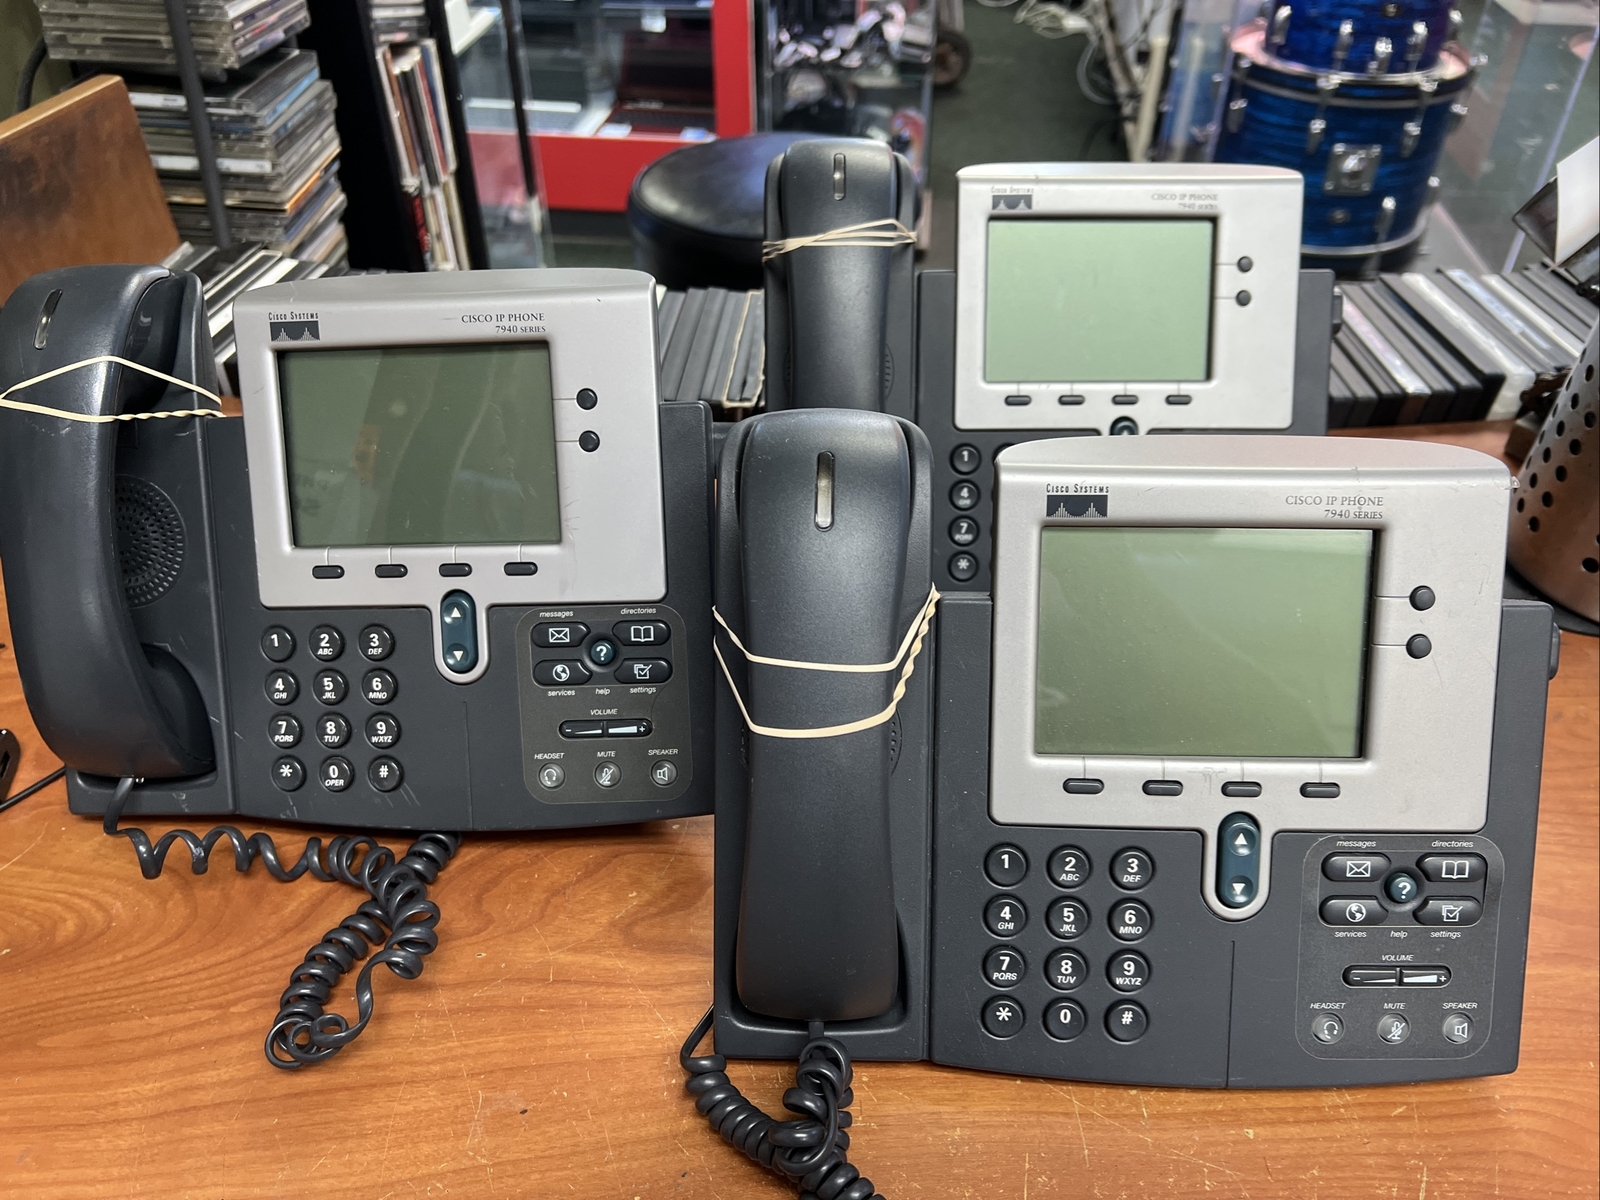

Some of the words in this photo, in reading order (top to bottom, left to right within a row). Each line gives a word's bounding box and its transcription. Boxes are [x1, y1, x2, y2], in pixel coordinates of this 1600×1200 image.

[461, 314, 493, 323] CISCO
[496, 313, 505, 322] IP
[508, 313, 545, 322] PHONE
[495, 325, 518, 333] 7940
[962, 451, 969, 461] 1
[960, 487, 969, 498] 4
[1285, 495, 1322, 505] CISCO
[1326, 496, 1337, 505] IP
[1341, 496, 1384, 507] PHONE
[1324, 509, 1351, 519] 7940
[1353, 511, 1383, 519] SERIES
[960, 523, 968, 533] 7
[539, 610, 574, 618] messages
[620, 607, 657, 615] directories
[271, 633, 279, 647] 1
[320, 633, 330, 647] 2
[369, 633, 380, 647] 3
[275, 678, 284, 691] 4
[323, 678, 334, 691] 5
[372, 678, 382, 691] 6
[548, 689, 576, 697] services
[629, 686, 657, 694] settings
[277, 721, 287, 734] 7
[326, 721, 336, 734] 8
[376, 721, 387, 734] 9
[534, 752, 565, 760] HEADSET
[648, 748, 678, 756] SPEAKER
[329, 765, 339, 778] 0
[379, 765, 389, 778] #
[1336, 840, 1377, 849] messages
[1431, 839, 1474, 848] directories
[1001, 854, 1009, 869] 1
[1064, 857, 1076, 871] 2
[1126, 858, 1139, 873] 3
[1059, 873, 1080, 881] ABC
[1122, 874, 1142, 883] DEF
[1000, 906, 1012, 920] 4
[1063, 908, 1075, 922] 5
[1124, 910, 1136, 924] 6
[997, 922, 1015, 930] GHI
[1060, 924, 1077, 932] JKL
[1119, 926, 1143, 934] MNO
[1334, 930, 1367, 938] services
[1390, 930, 1408, 938] help
[1430, 930, 1461, 939] settings
[999, 956, 1010, 971] 7
[1060, 960, 1072, 974] 8
[1123, 961, 1135, 975] 9
[993, 972, 1018, 981] PQRS
[1057, 975, 1076, 984] TUV
[1115, 977, 1142, 986] WXYZ
[1059, 1009, 1071, 1024] 0
[1121, 1010, 1133, 1025] #
